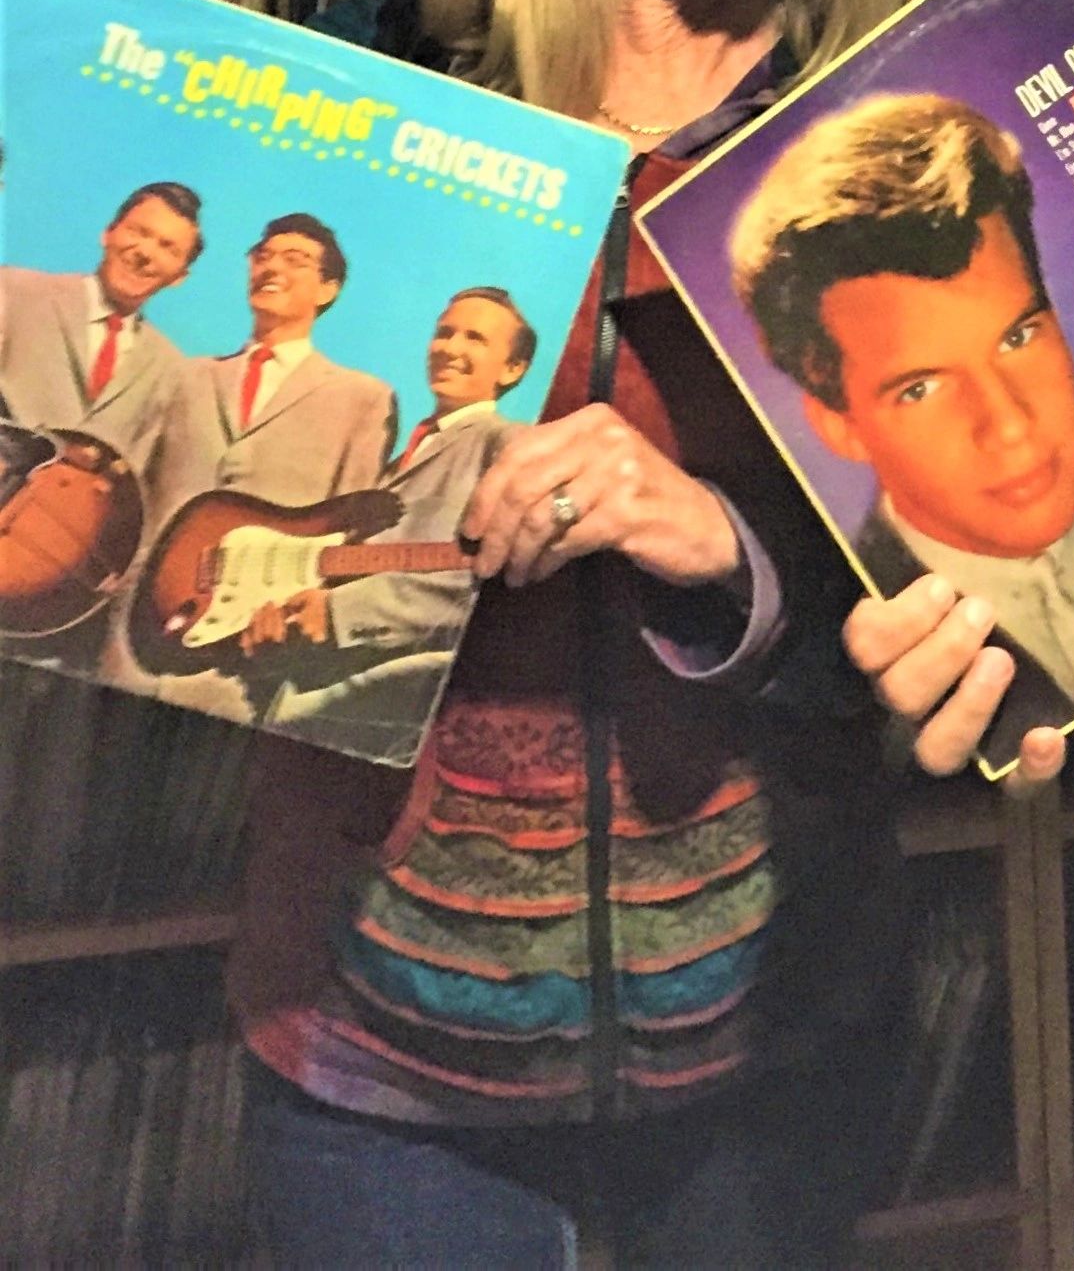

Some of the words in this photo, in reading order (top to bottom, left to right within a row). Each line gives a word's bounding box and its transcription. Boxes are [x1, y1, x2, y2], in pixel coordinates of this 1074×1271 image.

[99, 21, 166, 80] The
[391, 119, 567, 210] CRICKETS
[1015, 63, 1074, 118] DEVIL
